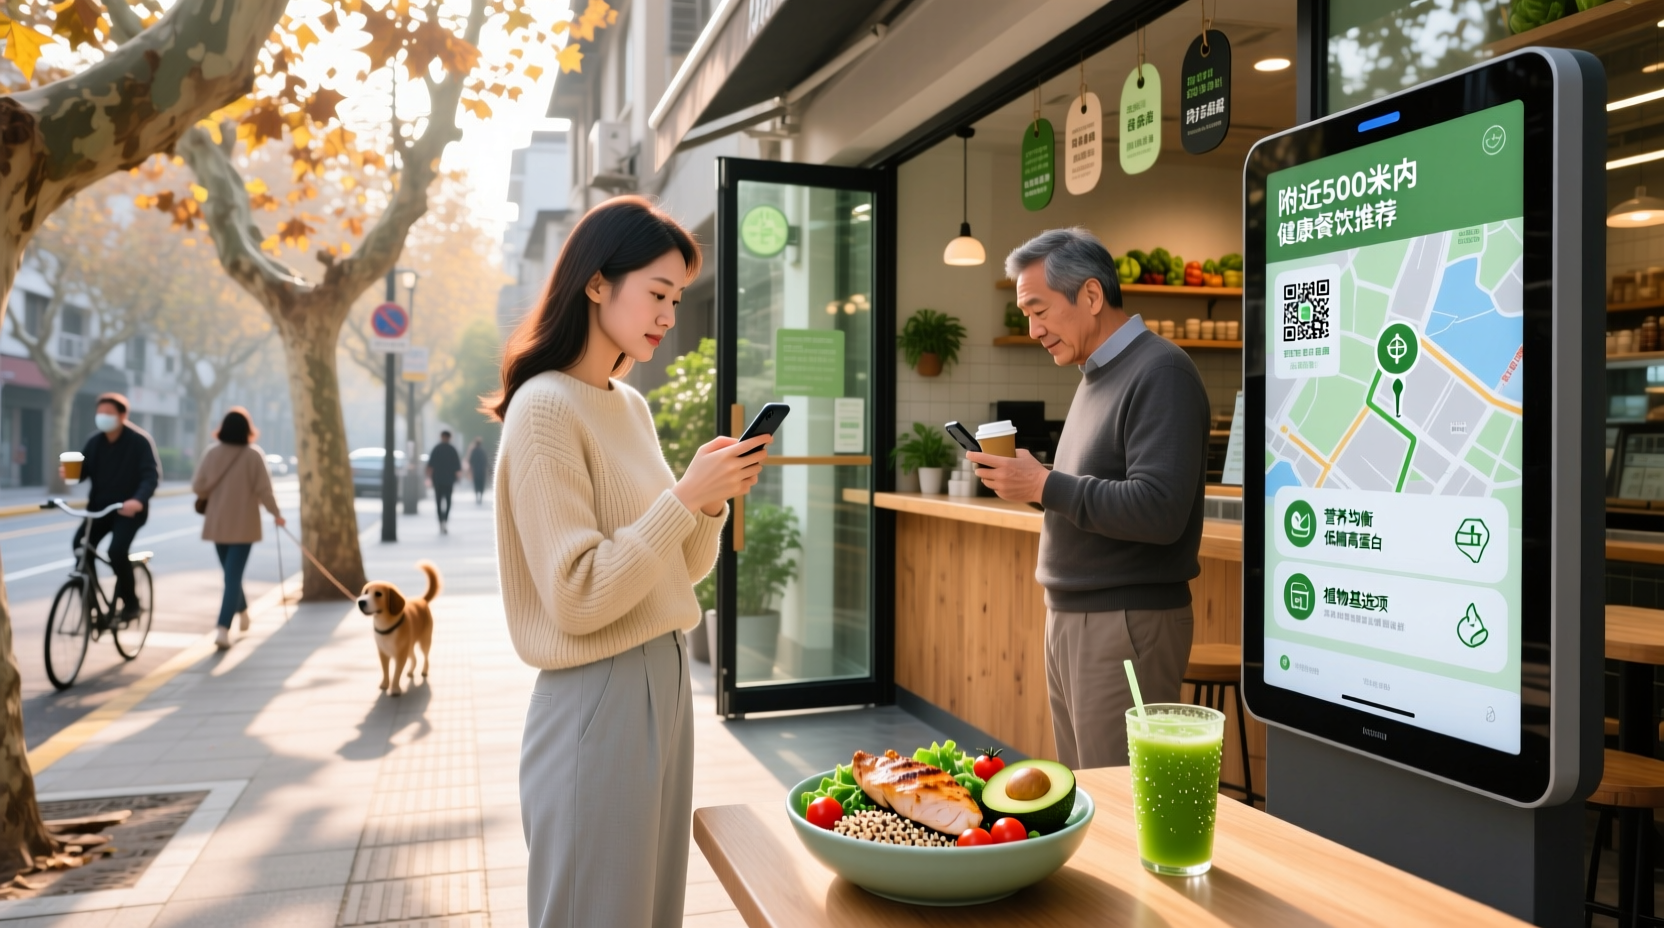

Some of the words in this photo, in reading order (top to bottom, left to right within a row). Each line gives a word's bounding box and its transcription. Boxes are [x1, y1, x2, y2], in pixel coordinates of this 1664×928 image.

[1278, 157, 1417, 217] 附近500米内
[1277, 198, 1397, 247] 健康餐饮推荐
[1324, 508, 1374, 528] 营养均衡
